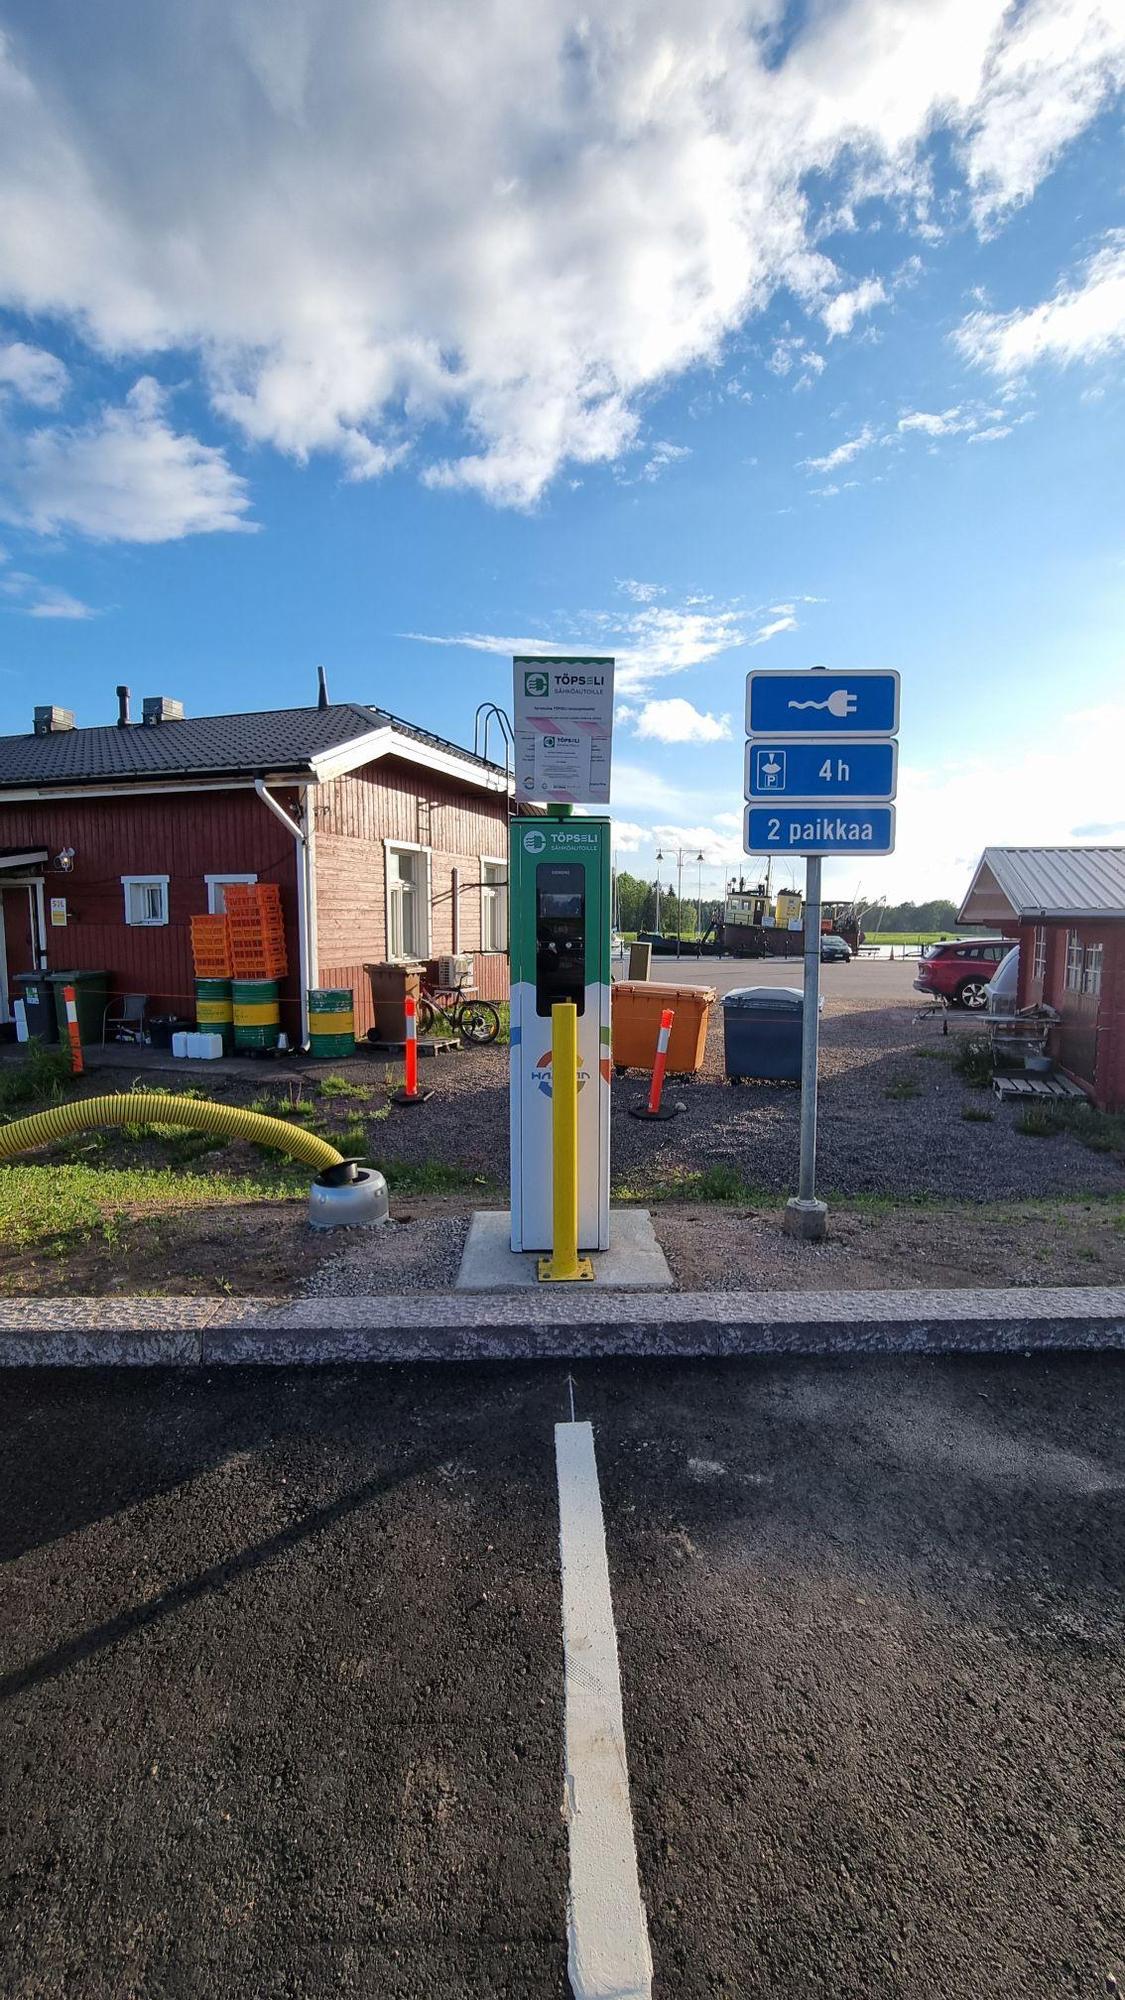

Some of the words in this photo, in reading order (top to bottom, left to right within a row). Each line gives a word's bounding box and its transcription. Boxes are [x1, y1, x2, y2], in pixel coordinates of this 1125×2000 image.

[554, 672, 604, 686] TÖPSELI
[819, 759, 832, 782] 4
[837, 759, 850, 782] h
[550, 831, 598, 843] TÖPSELI
[767, 818, 780, 840] 2
[789, 818, 873, 844] paikkaa
